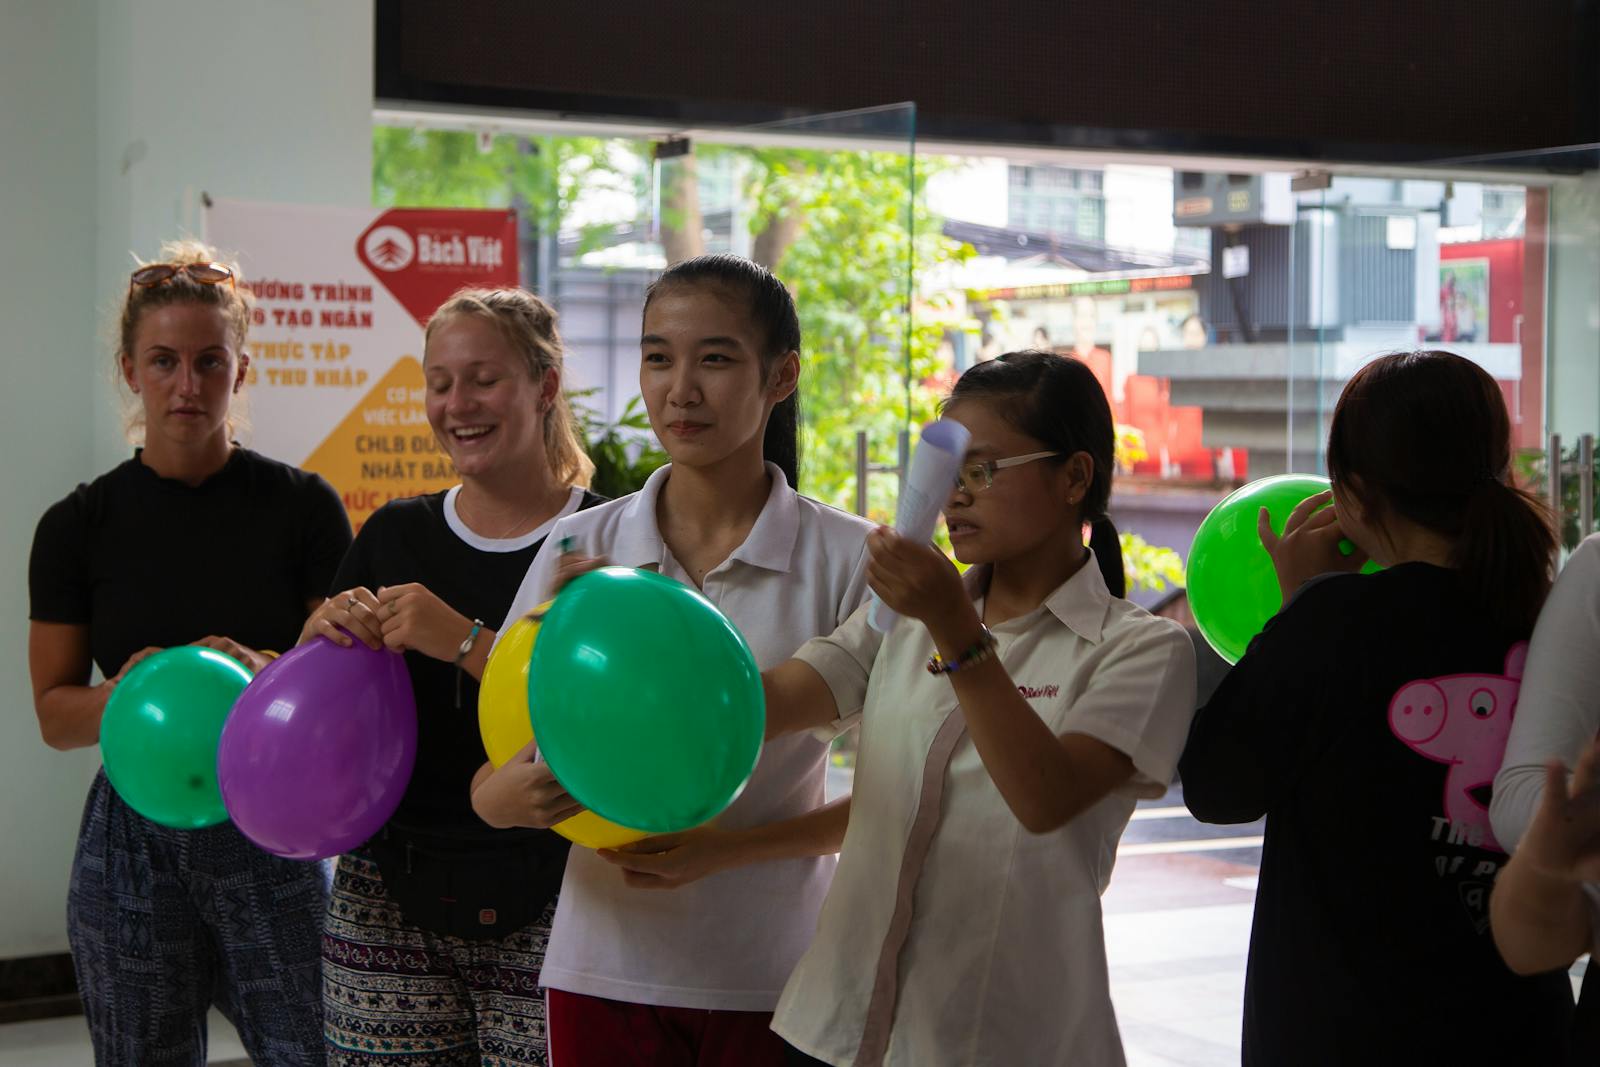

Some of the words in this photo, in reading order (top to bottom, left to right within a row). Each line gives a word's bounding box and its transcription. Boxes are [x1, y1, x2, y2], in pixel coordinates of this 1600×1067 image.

[416, 232, 465, 265] Bách
[466, 235, 503, 271] Việt
[355, 435, 405, 454] CHLB
